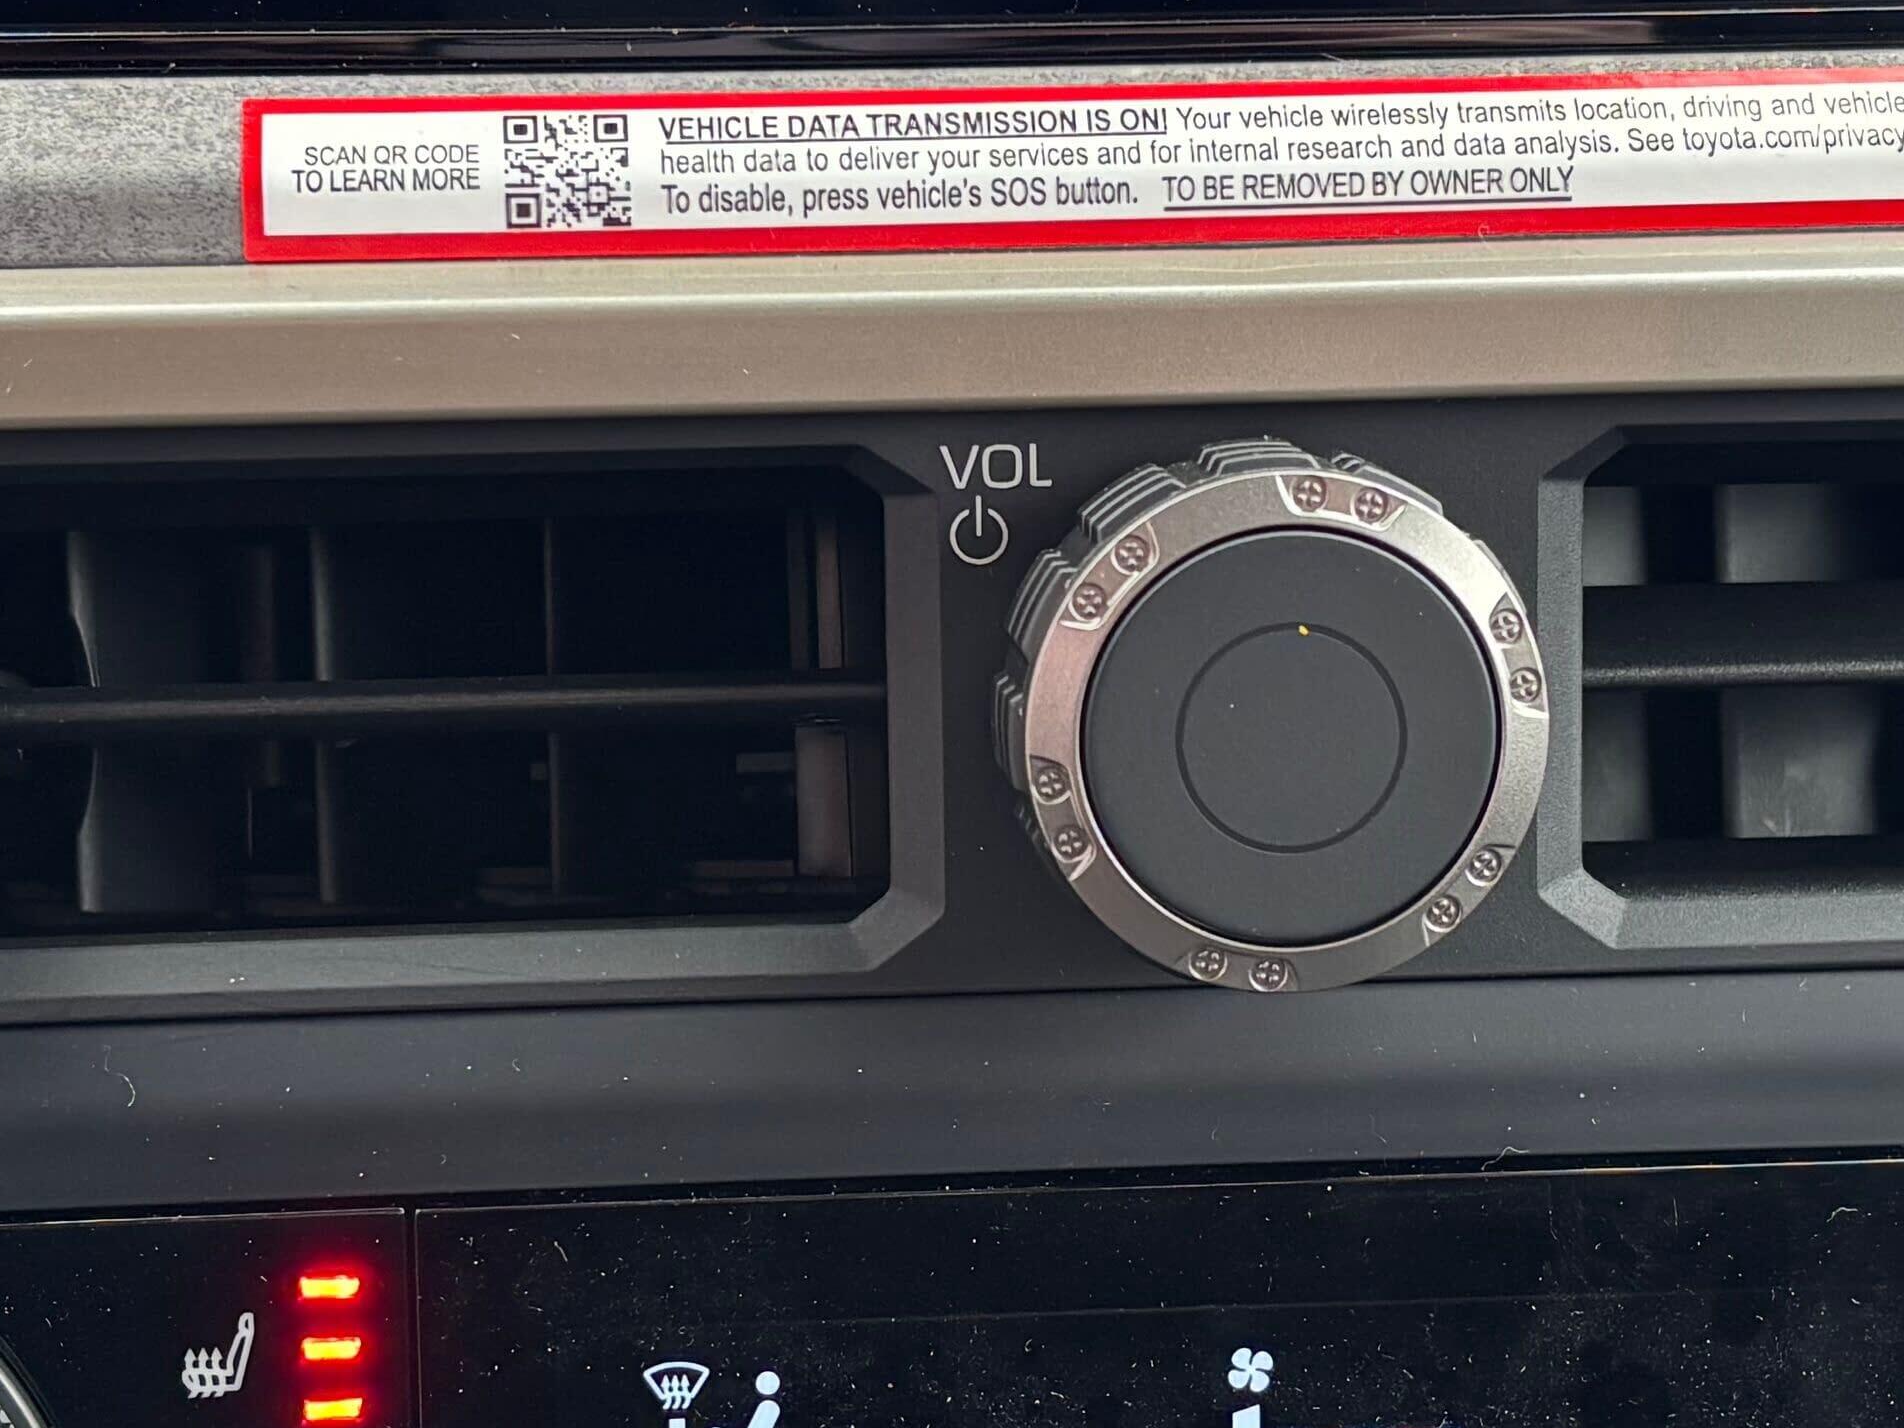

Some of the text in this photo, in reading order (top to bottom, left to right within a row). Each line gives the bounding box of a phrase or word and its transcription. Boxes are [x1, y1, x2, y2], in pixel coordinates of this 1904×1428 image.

[659, 116, 779, 140] VEHICLE
[788, 114, 860, 138] DATA
[866, 108, 1076, 136] TRANSMISSION
[1087, 108, 1111, 132] IS
[1120, 107, 1167, 131] ON!
[1176, 107, 1231, 130] Your
[1239, 104, 1323, 128] vehicle
[1331, 101, 1448, 129] wirelessly
[1457, 99, 1566, 124] transmits
[1576, 96, 1675, 122] location,
[1683, 94, 1762, 121] driving
[1771, 93, 1815, 116] and
[304, 144, 480, 165] SCAN QR CODE
[661, 149, 734, 174] health
[744, 148, 796, 172] data
[807, 148, 828, 171] to
[839, 146, 919, 171] deliver
[929, 150, 980, 176] your
[989, 142, 1088, 168] services
[1097, 140, 1141, 164] and
[1151, 139, 1181, 164] for
[1190, 137, 1278, 163] internal
[1288, 134, 1392, 161] research
[1401, 133, 1445, 158] and
[1454, 132, 1506, 156] data
[1515, 128, 1619, 160] analysis.
[1628, 127, 1674, 152] See
[291, 168, 481, 193] TO LEARN MORE
[660, 184, 690, 214] To
[698, 182, 793, 216] disable,
[803, 185, 869, 219] press
[991, 177, 1046, 206] SOS
[1056, 176, 1138, 205] button.
[1162, 176, 1195, 202] TO
[1203, 174, 1235, 200] BE
[1243, 171, 1365, 200] REMOVED
[1372, 170, 1404, 196] BY
[1410, 168, 1504, 196] OWNER
[1510, 165, 1574, 193] ONLY
[939, 442, 1053, 490] VOL
